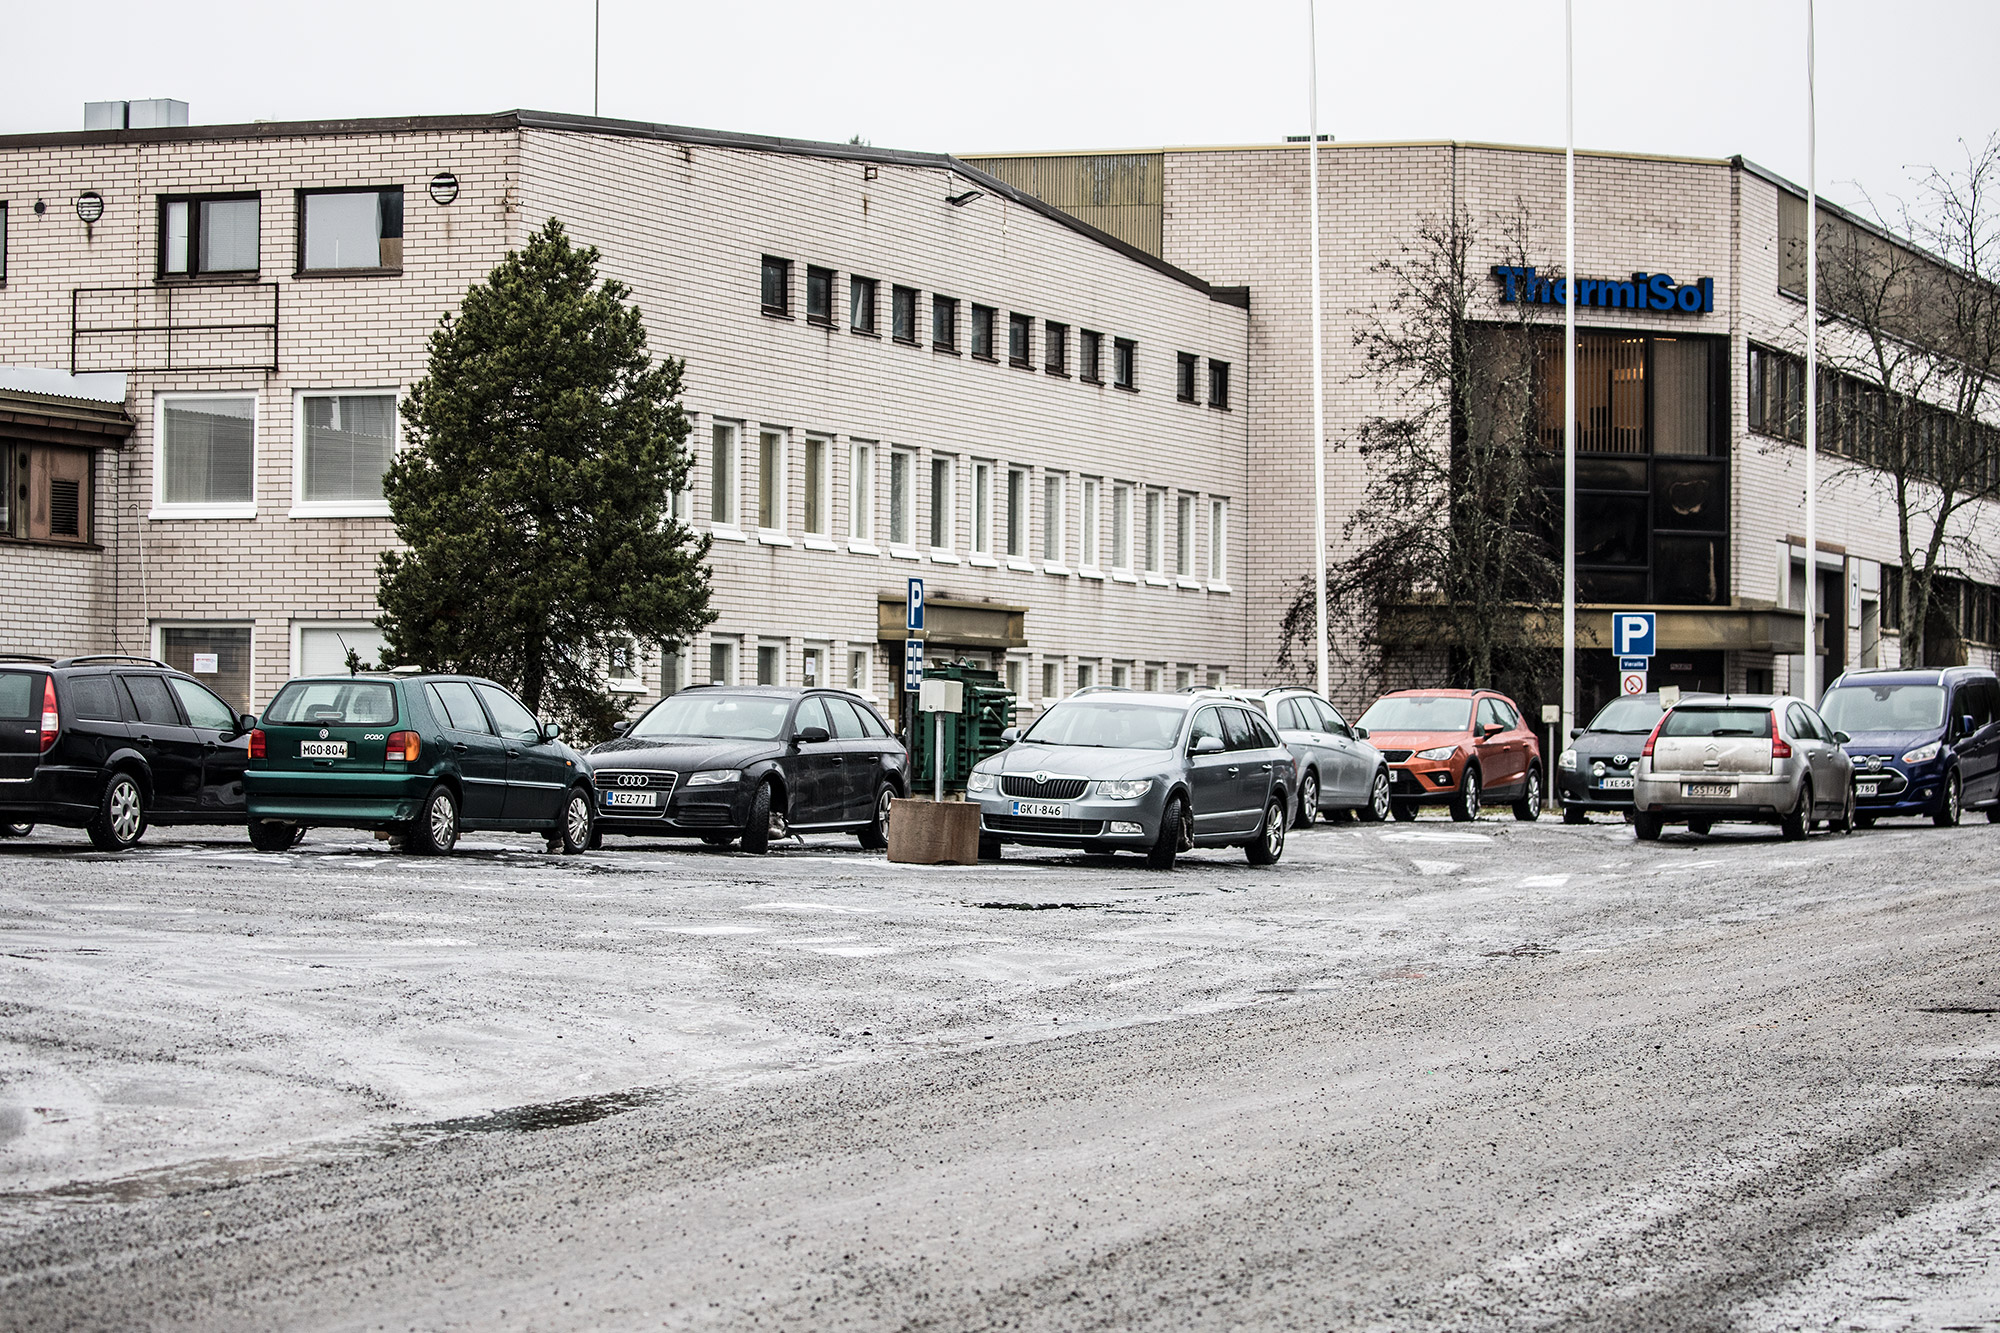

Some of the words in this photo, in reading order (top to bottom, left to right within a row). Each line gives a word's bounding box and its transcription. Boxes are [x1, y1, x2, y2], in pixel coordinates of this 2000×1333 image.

[1491, 266, 1714, 313] ThermiSol
[910, 581, 922, 625] P
[1622, 616, 1649, 653] P
[303, 745, 345, 755] MGO-804
[614, 794, 652, 805] XEZ-771
[1020, 803, 1061, 816] GKI-846
